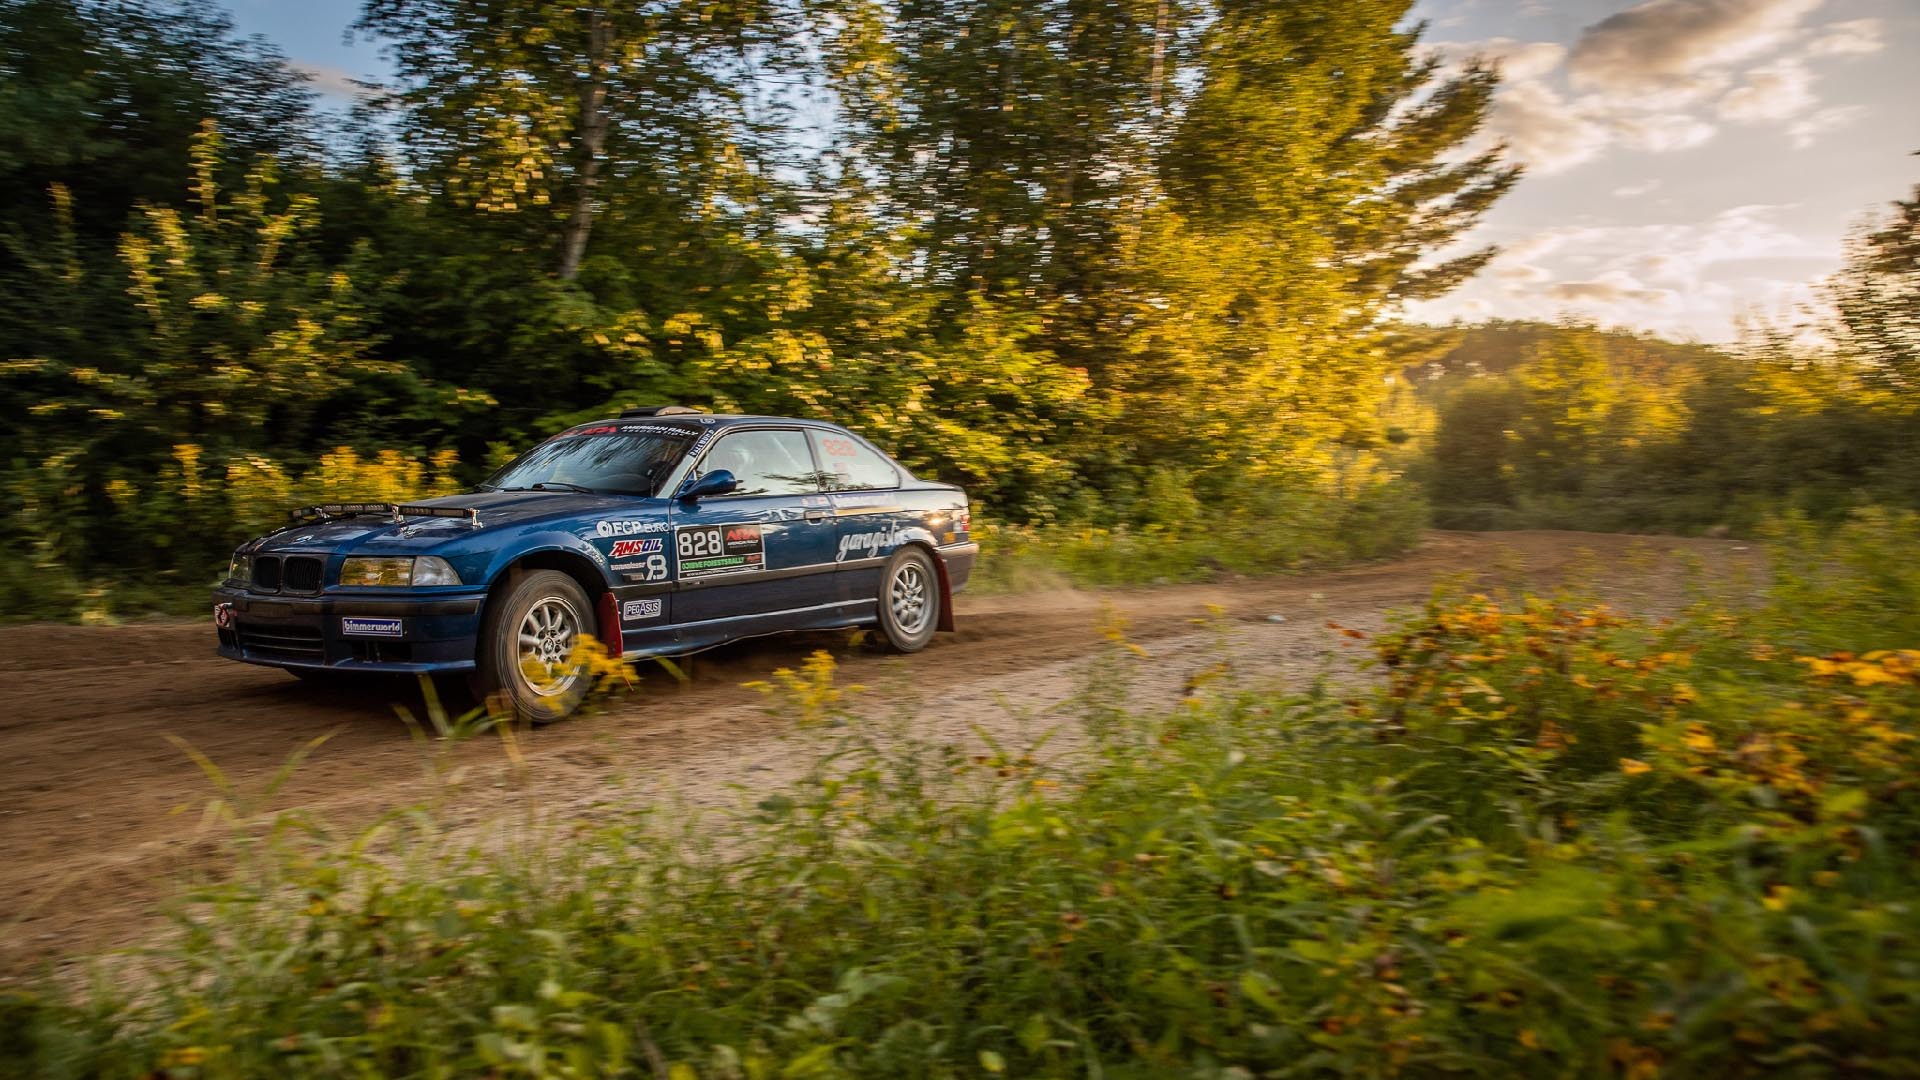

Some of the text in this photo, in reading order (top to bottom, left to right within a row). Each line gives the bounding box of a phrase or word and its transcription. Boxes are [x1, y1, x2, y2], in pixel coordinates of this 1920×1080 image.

[668, 427, 699, 436] RALLY
[609, 538, 662, 558] AMSOIL
[678, 530, 722, 556] 828
[627, 601, 660, 616] PEGASUS
[344, 620, 401, 632] bimmerworld
